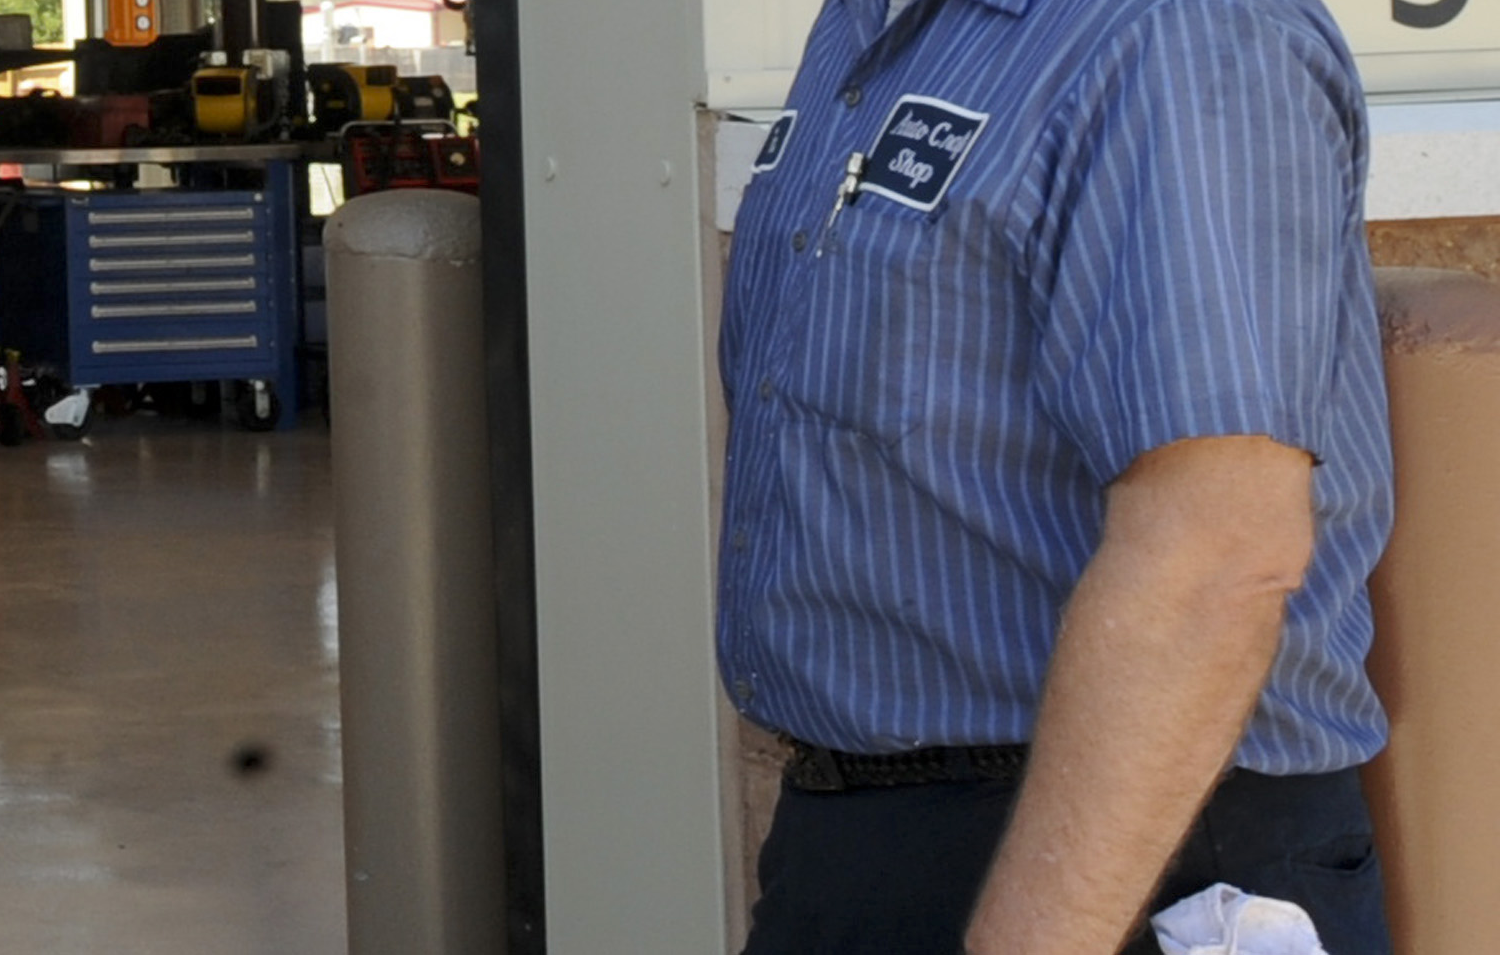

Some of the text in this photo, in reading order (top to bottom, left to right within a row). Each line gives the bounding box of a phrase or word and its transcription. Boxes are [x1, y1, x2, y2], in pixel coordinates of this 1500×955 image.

[889, 109, 973, 161] Auto Craft
[888, 148, 934, 189] Shop
